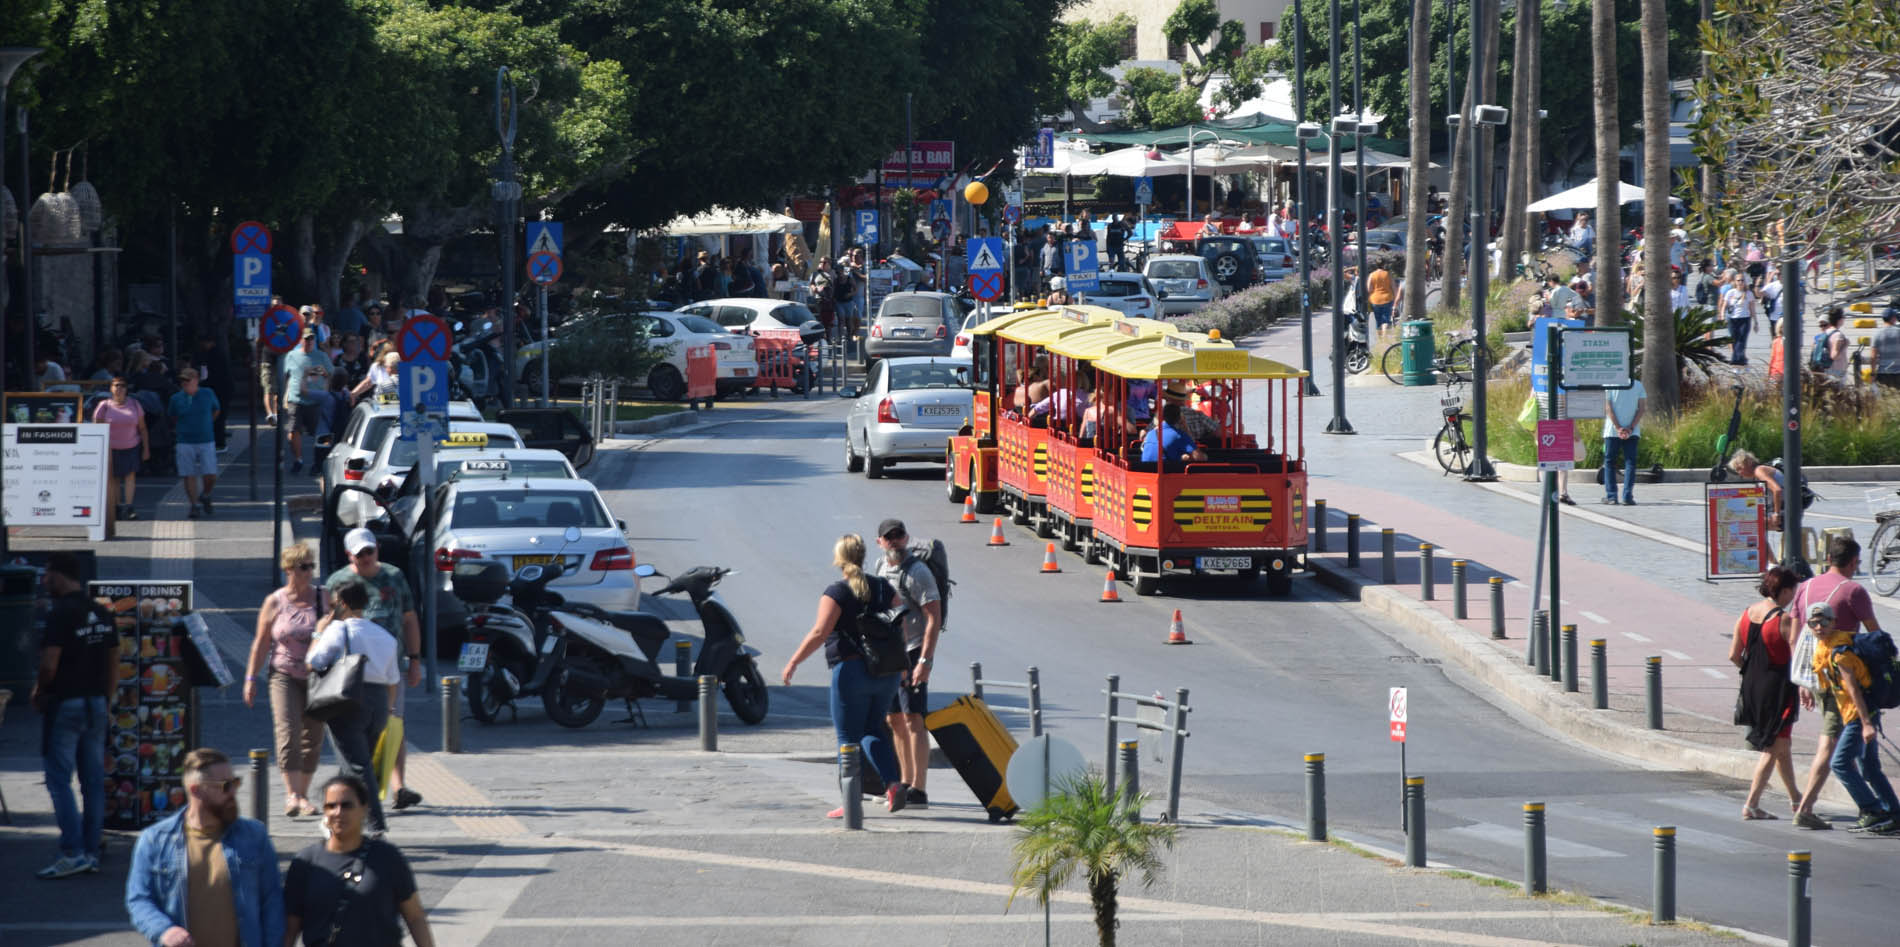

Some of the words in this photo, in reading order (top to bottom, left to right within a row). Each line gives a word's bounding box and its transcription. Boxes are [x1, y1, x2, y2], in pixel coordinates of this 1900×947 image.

[926, 150, 952, 164] BAR
[861, 212, 874, 227] P
[1072, 244, 1090, 271] P
[243, 257, 263, 286] P
[1072, 272, 1093, 280] TAXI
[411, 366, 436, 407] P
[22, 431, 32, 439] IN
[34, 431, 73, 439] FASHION
[452, 434, 485, 442] TAXI
[471, 461, 506, 469] TAXI
[1193, 515, 1255, 525] DELTRAIN
[98, 586, 132, 596] FOOD
[141, 586, 183, 596] DRINKS
